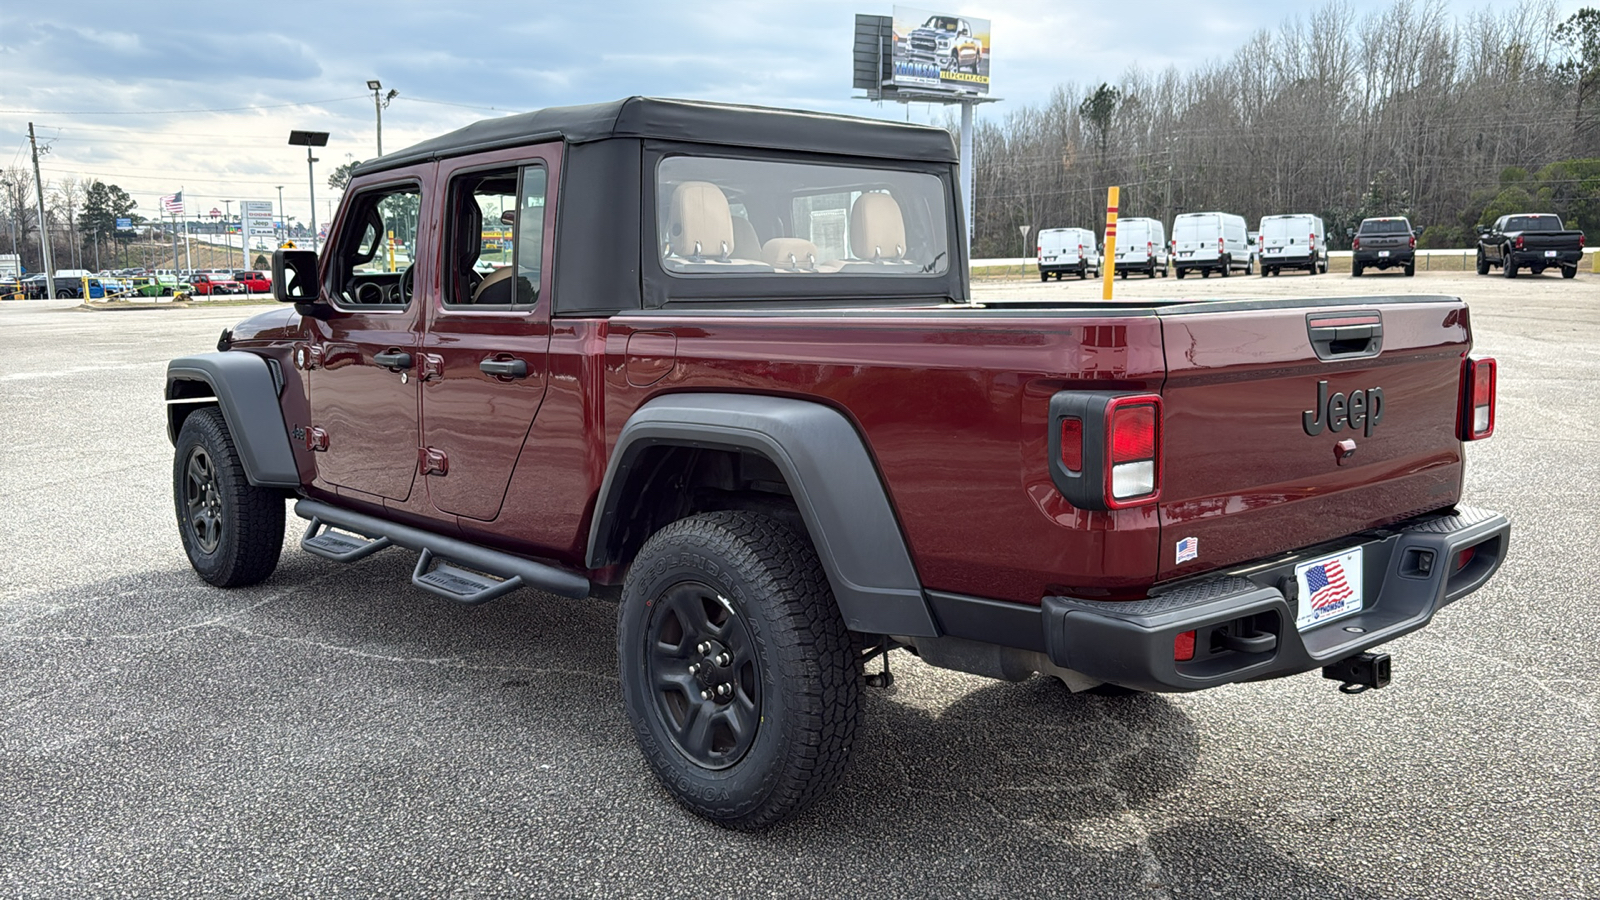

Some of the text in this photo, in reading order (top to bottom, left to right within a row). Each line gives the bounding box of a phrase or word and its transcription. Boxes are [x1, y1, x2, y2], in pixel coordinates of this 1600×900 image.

[895, 61, 940, 78] THOMSON
[941, 71, 988, 83] JEEPCHEAP.COM
[1302, 380, 1385, 438] Jeep
[292, 424, 305, 440] Jeep
[638, 552, 746, 604] GEOLANDAR
[1320, 600, 1345, 614] THOMSON
[638, 717, 729, 801] YOKOHAMA
